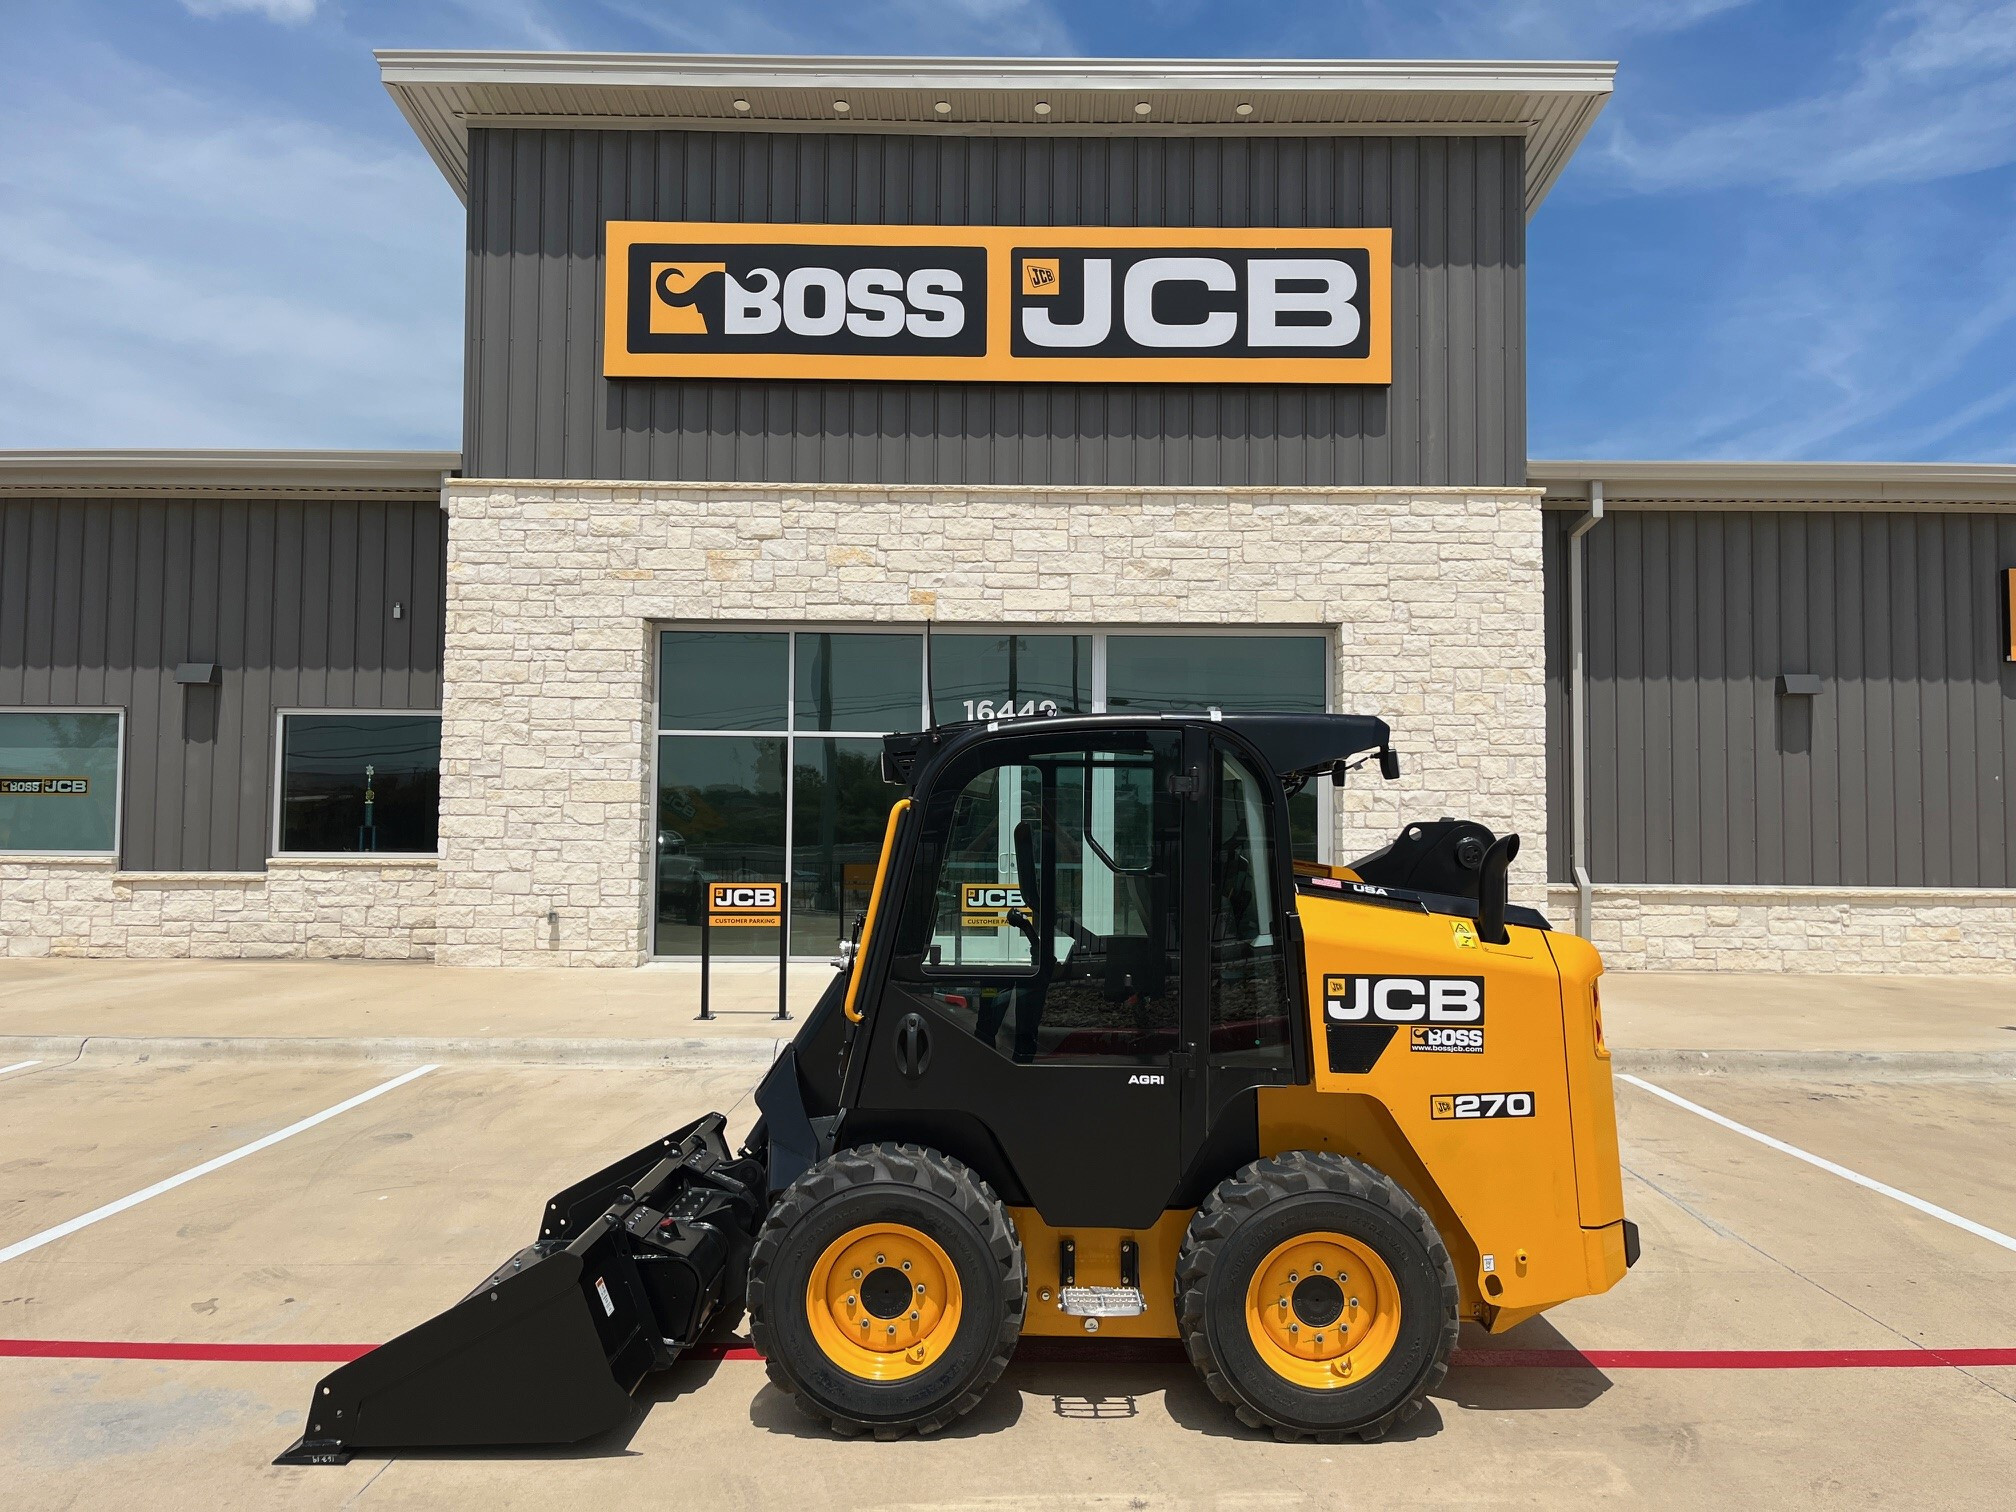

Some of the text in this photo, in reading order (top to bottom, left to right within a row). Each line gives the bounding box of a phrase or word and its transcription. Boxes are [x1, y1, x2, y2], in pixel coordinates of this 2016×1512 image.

[1032, 268, 1054, 286] JCB
[725, 257, 1360, 349] BOSS JCB
[10, 781, 87, 792] BOSS JCB
[716, 889, 775, 906] JCB
[1353, 884, 1388, 896] USA
[1328, 978, 1481, 1021] JCB
[1428, 1029, 1483, 1046] BOSS
[1128, 1075, 1164, 1085] AGRI
[1455, 1093, 1531, 1118] 270
